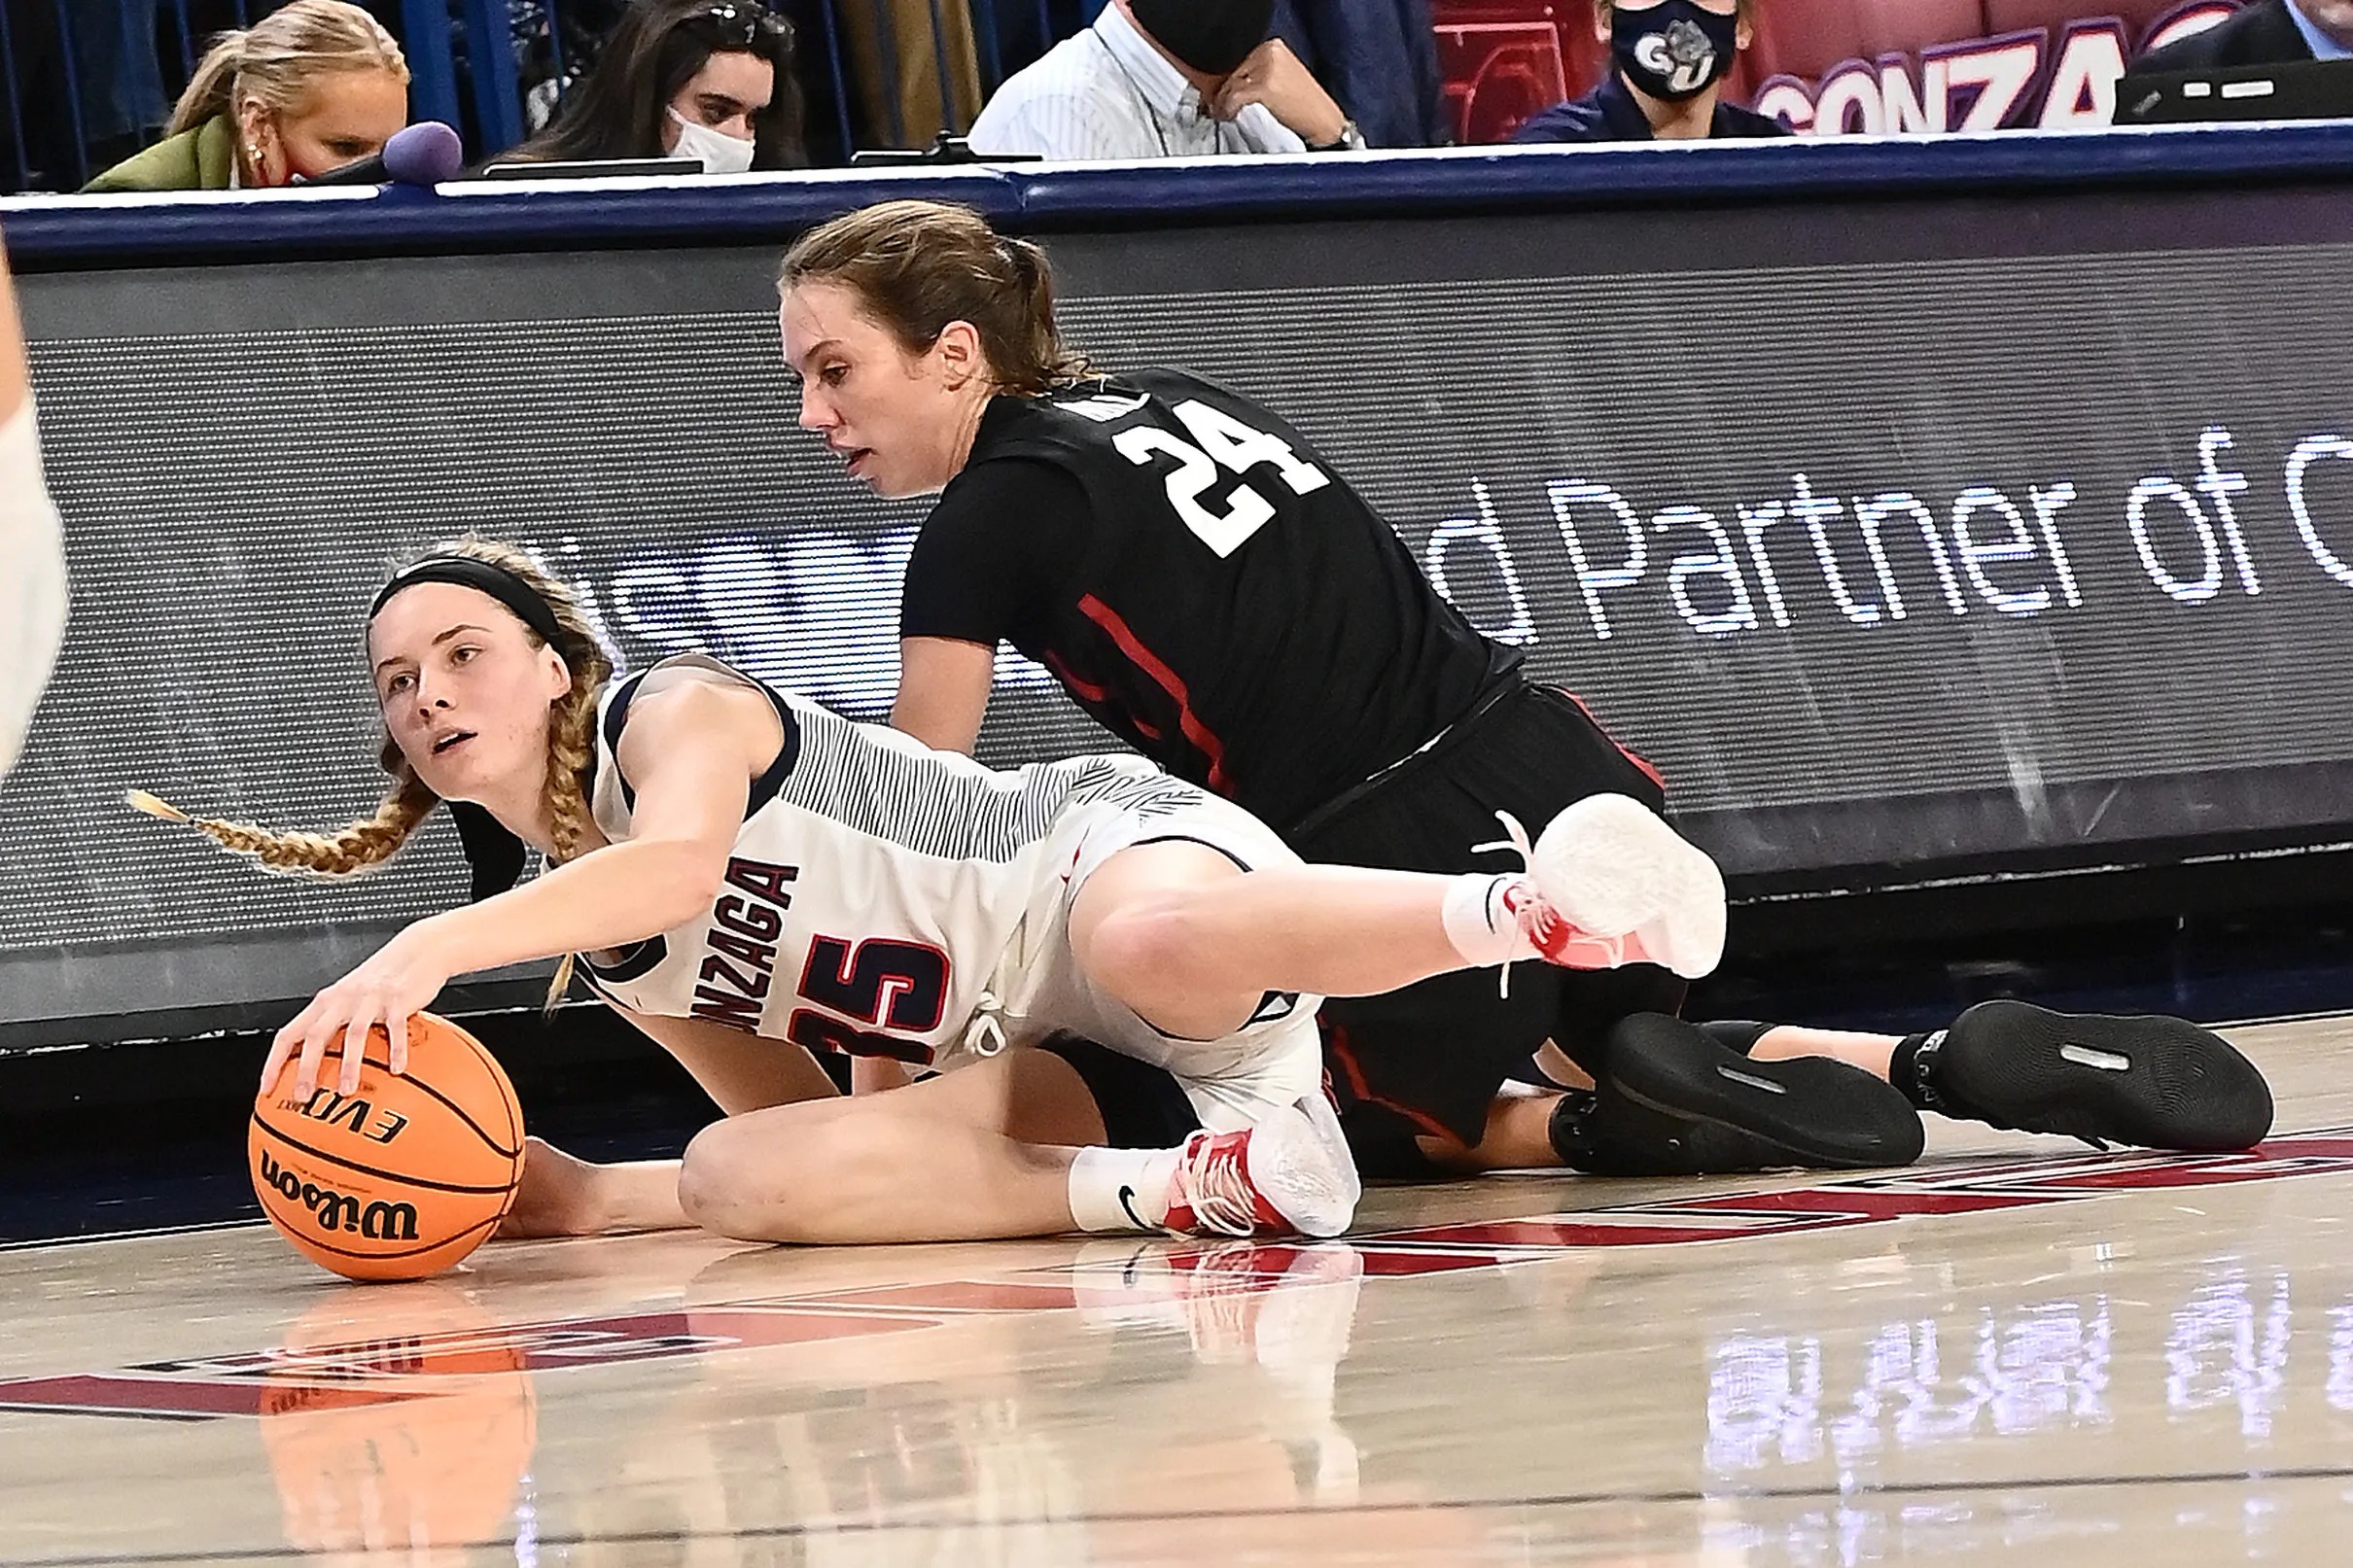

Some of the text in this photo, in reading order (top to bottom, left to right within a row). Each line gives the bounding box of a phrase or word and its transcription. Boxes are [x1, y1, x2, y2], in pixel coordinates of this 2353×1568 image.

[1111, 399, 1331, 558] 24
[1548, 471, 2083, 640] Partner
[2126, 425, 2261, 604] of
[689, 855, 799, 1035] NZAGA
[261, 1148, 419, 1240] Wilson
[302, 1087, 407, 1144] EVO
